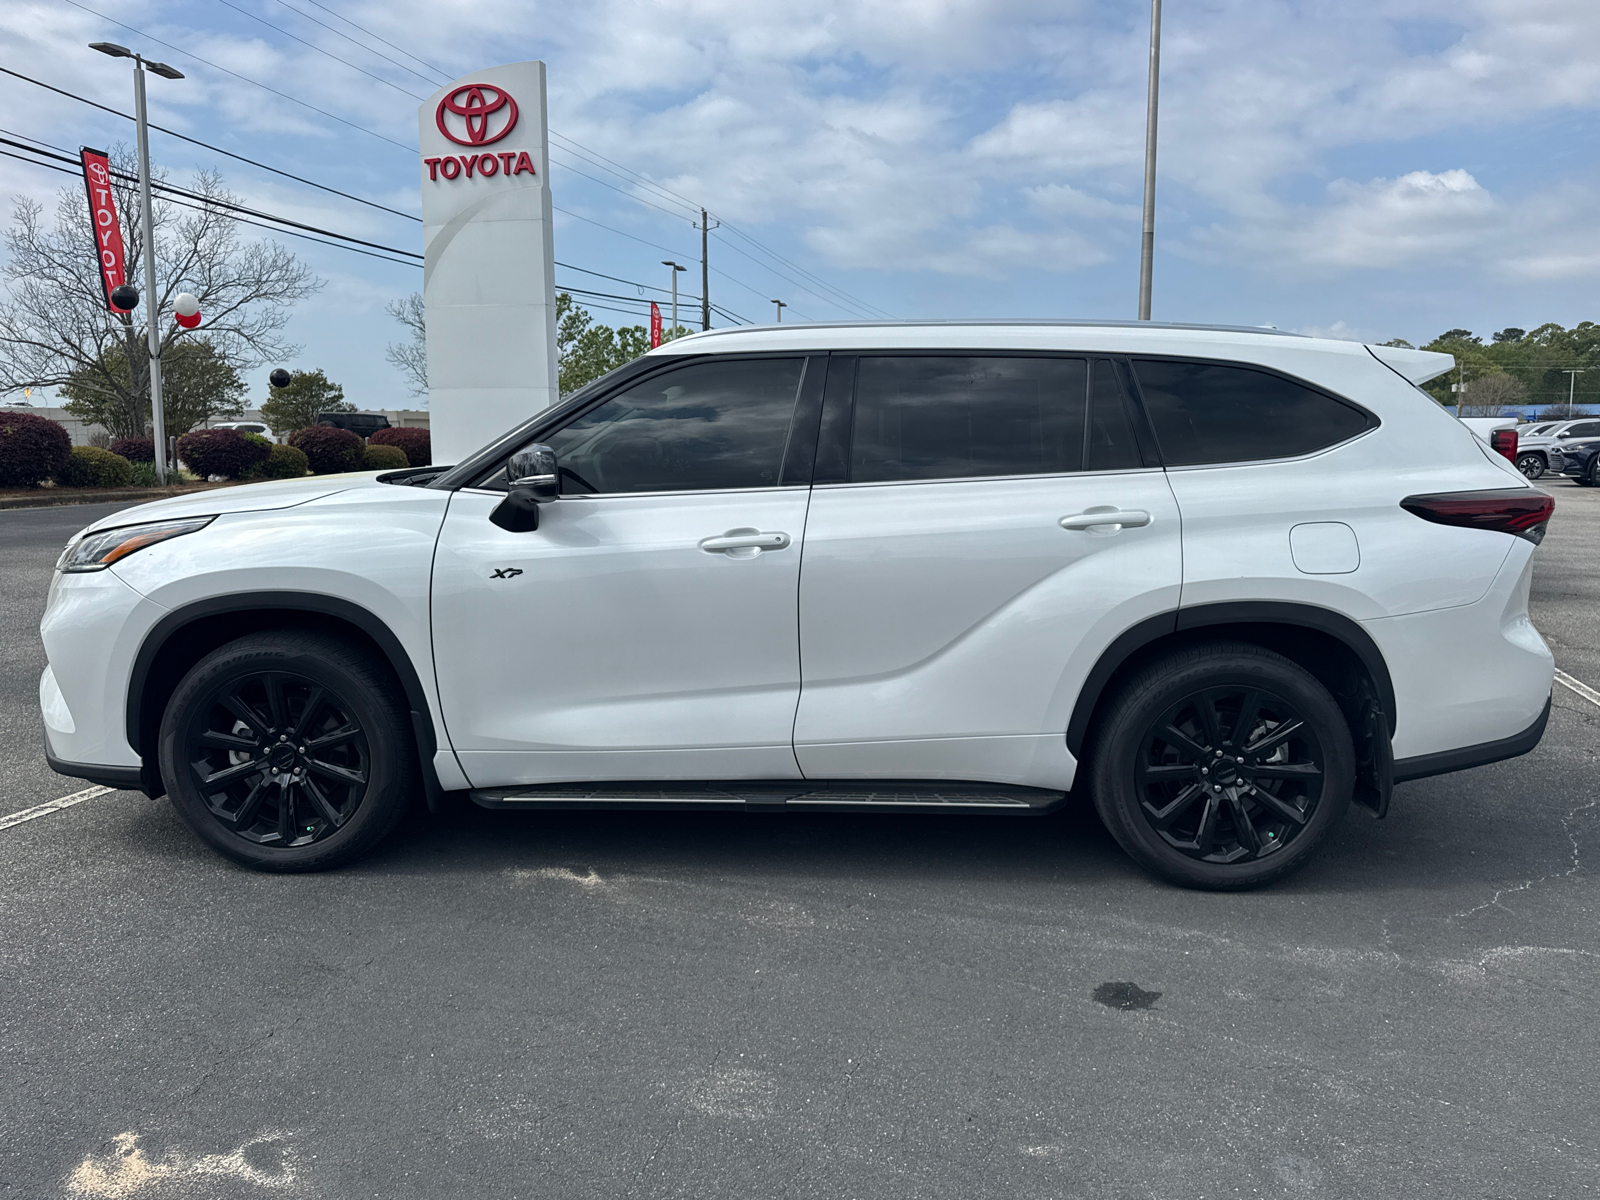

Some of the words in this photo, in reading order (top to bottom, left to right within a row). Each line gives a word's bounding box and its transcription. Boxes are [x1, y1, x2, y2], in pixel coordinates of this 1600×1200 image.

[424, 151, 536, 181] TOYOTA
[96, 188, 117, 287] TOYOT
[489, 567, 524, 579] XP
[210, 651, 286, 674] TOURING
